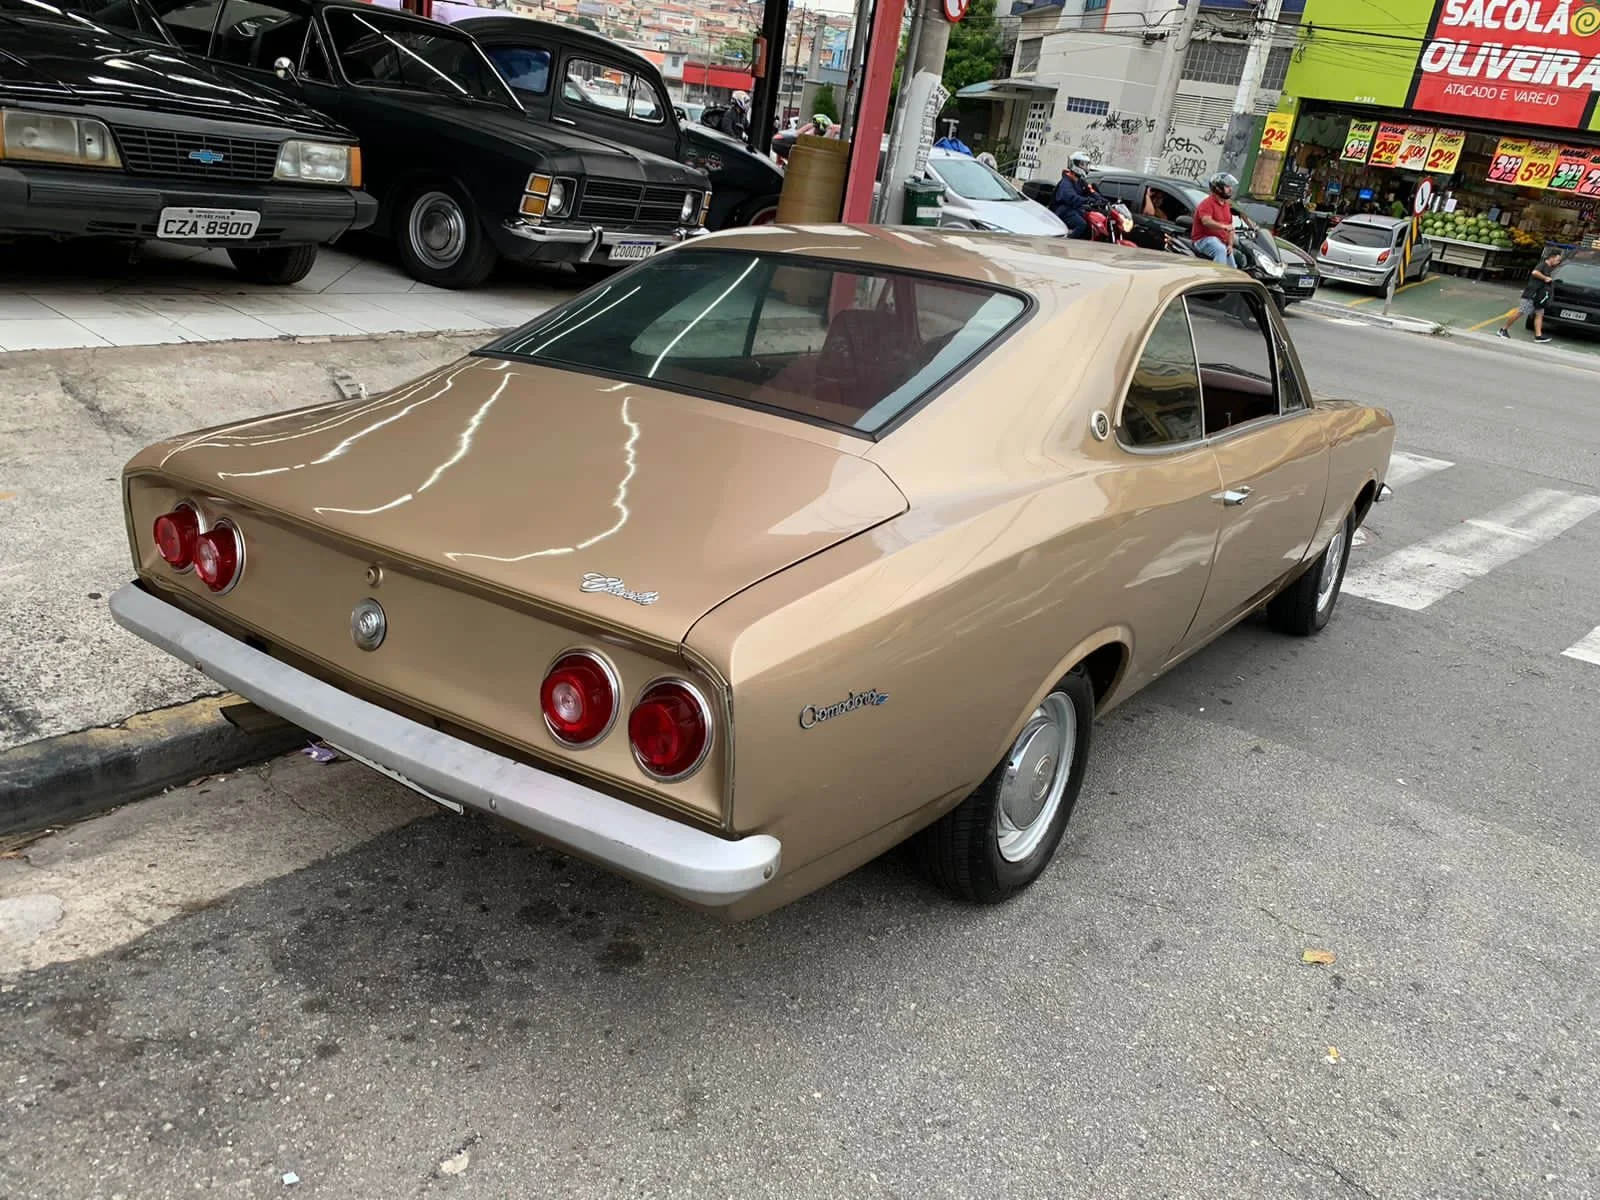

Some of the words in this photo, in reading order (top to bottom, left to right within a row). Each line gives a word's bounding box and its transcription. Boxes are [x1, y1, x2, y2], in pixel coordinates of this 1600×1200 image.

[1421, 38, 1600, 91] OLIVEIRA
[1444, 83, 1497, 99] ATACADO
[1500, 89, 1508, 100] E
[1514, 91, 1559, 106] VAREJO
[164, 219, 253, 235] CZA-8900
